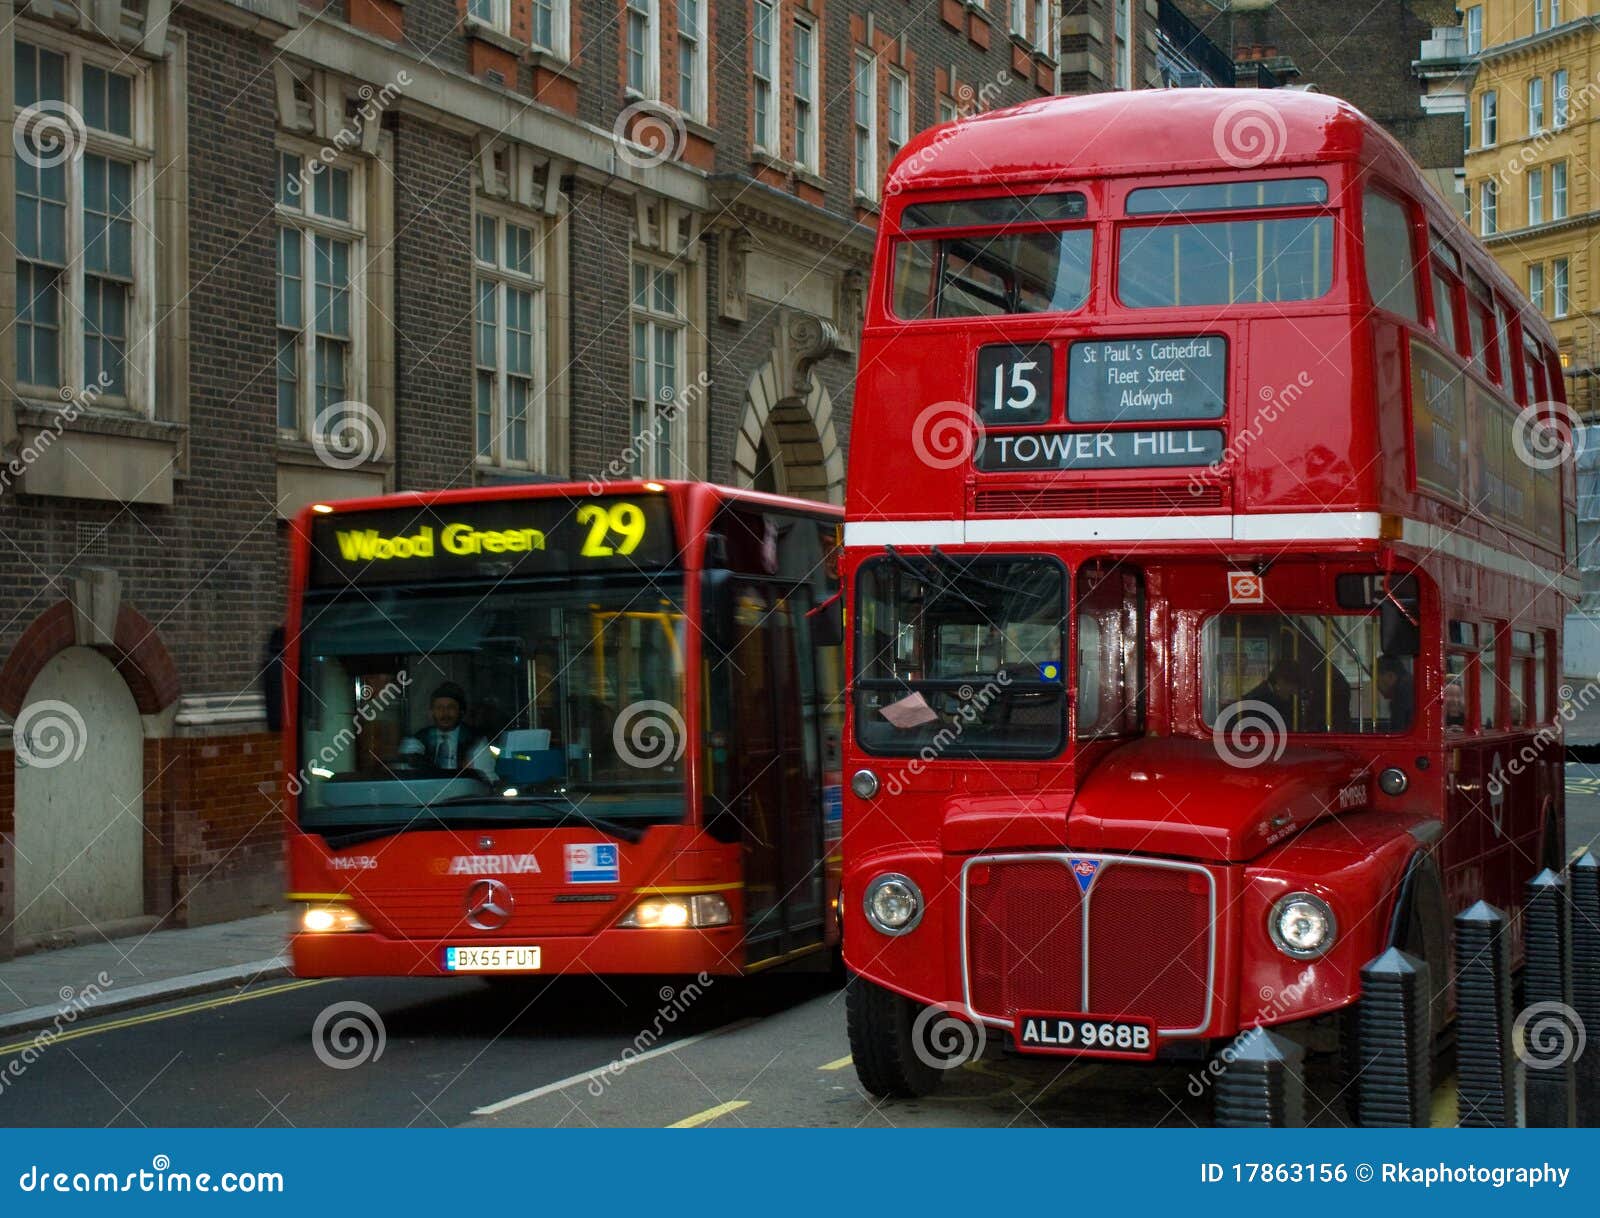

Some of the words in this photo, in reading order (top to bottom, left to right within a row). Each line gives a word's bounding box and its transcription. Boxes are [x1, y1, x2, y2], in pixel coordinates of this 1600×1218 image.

[1083, 347, 1097, 363] St
[1104, 345, 1143, 361] Paul's
[1151, 341, 1212, 360] Cathedral
[994, 361, 1038, 410] 15
[1108, 368, 1140, 384] Fleet
[1147, 366, 1185, 383] Street
[1120, 388, 1173, 411] Aldwych
[994, 432, 1116, 463] TOWER
[1134, 430, 1205, 456] HILL
[336, 526, 434, 561] Wood
[441, 522, 545, 555] Green
[576, 502, 646, 557] 29
[449, 854, 542, 875] ARRIVA
[459, 950, 500, 966] BX55
[505, 949, 537, 966] FUT
[1023, 1019, 1075, 1044] ALD
[1080, 1022, 1150, 1049] 968B
